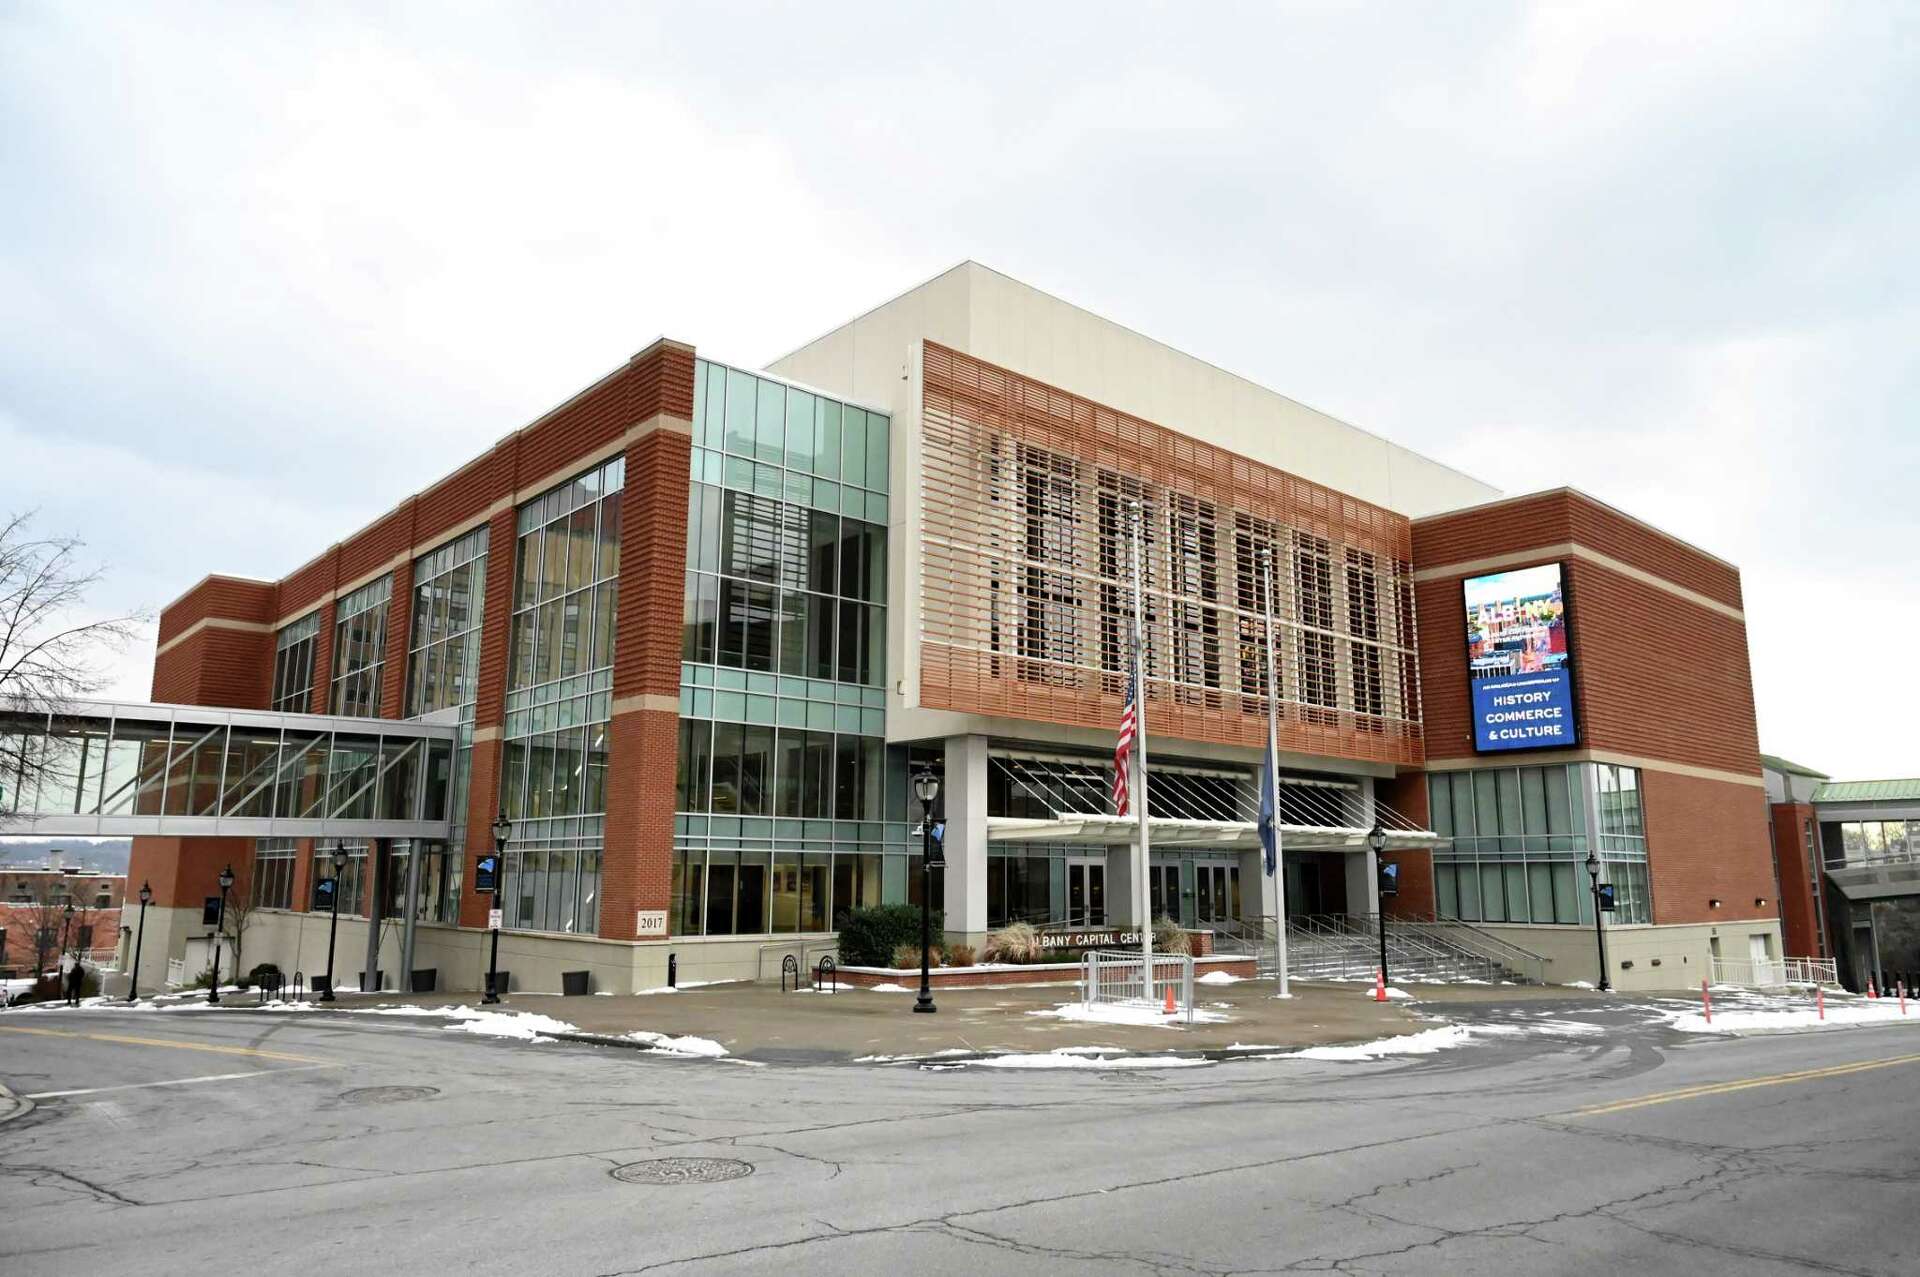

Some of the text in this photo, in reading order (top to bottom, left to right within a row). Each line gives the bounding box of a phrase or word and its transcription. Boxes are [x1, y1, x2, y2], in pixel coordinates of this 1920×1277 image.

[1494, 692, 1551, 706] HISTORY
[1486, 707, 1562, 723] COMMERCE
[1489, 725, 1562, 740] & CULTURE
[641, 917, 663, 928] 2017
[1076, 933, 1115, 945] CAPITAL
[1120, 932, 1157, 943] CENTR
